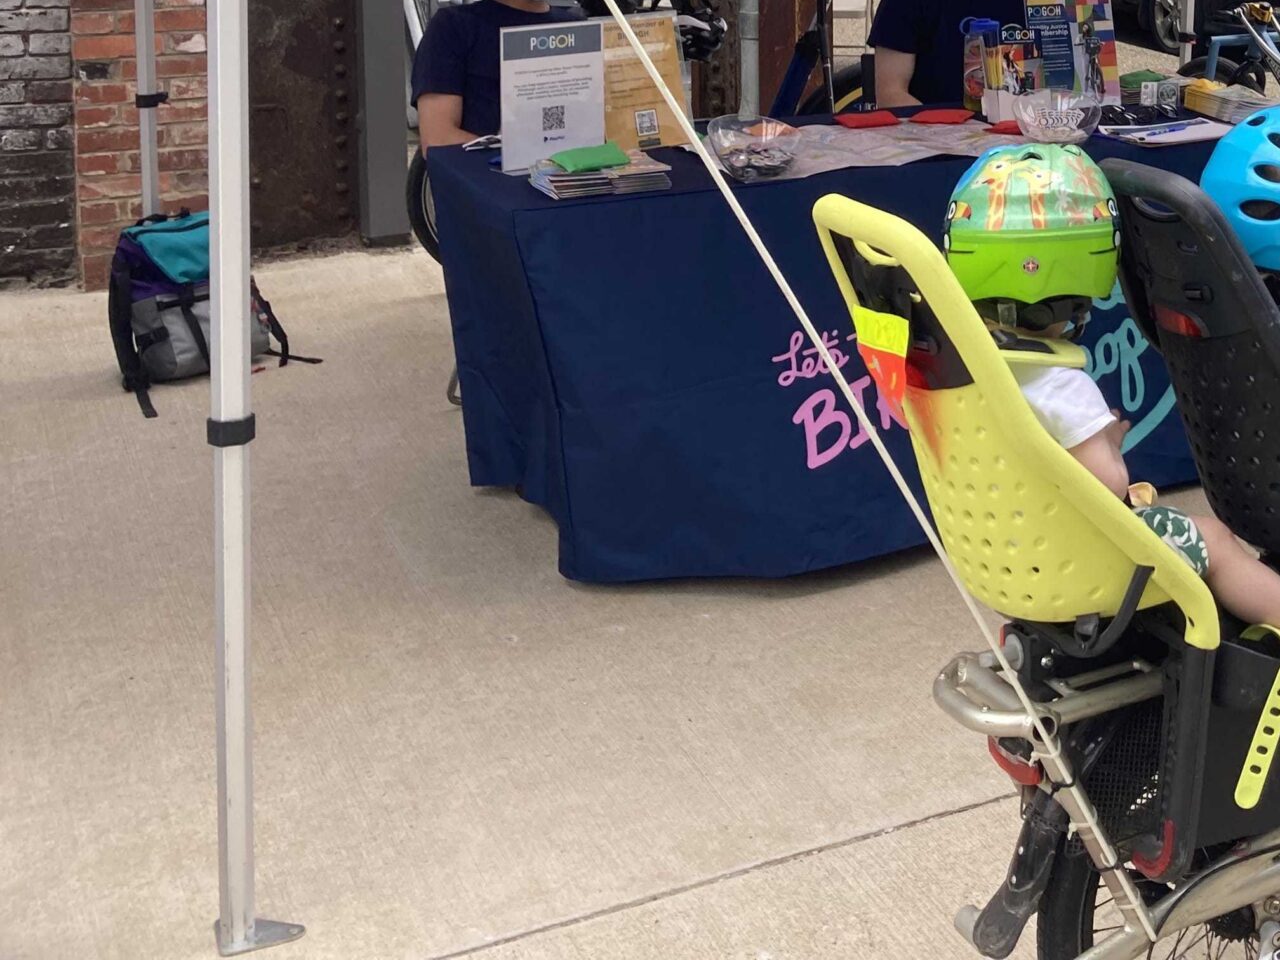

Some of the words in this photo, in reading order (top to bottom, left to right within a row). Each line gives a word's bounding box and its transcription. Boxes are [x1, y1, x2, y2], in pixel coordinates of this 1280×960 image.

[1028, 6, 1062, 17] POGOH
[1001, 29, 1035, 41] POGOH
[530, 34, 575, 51] POGOH
